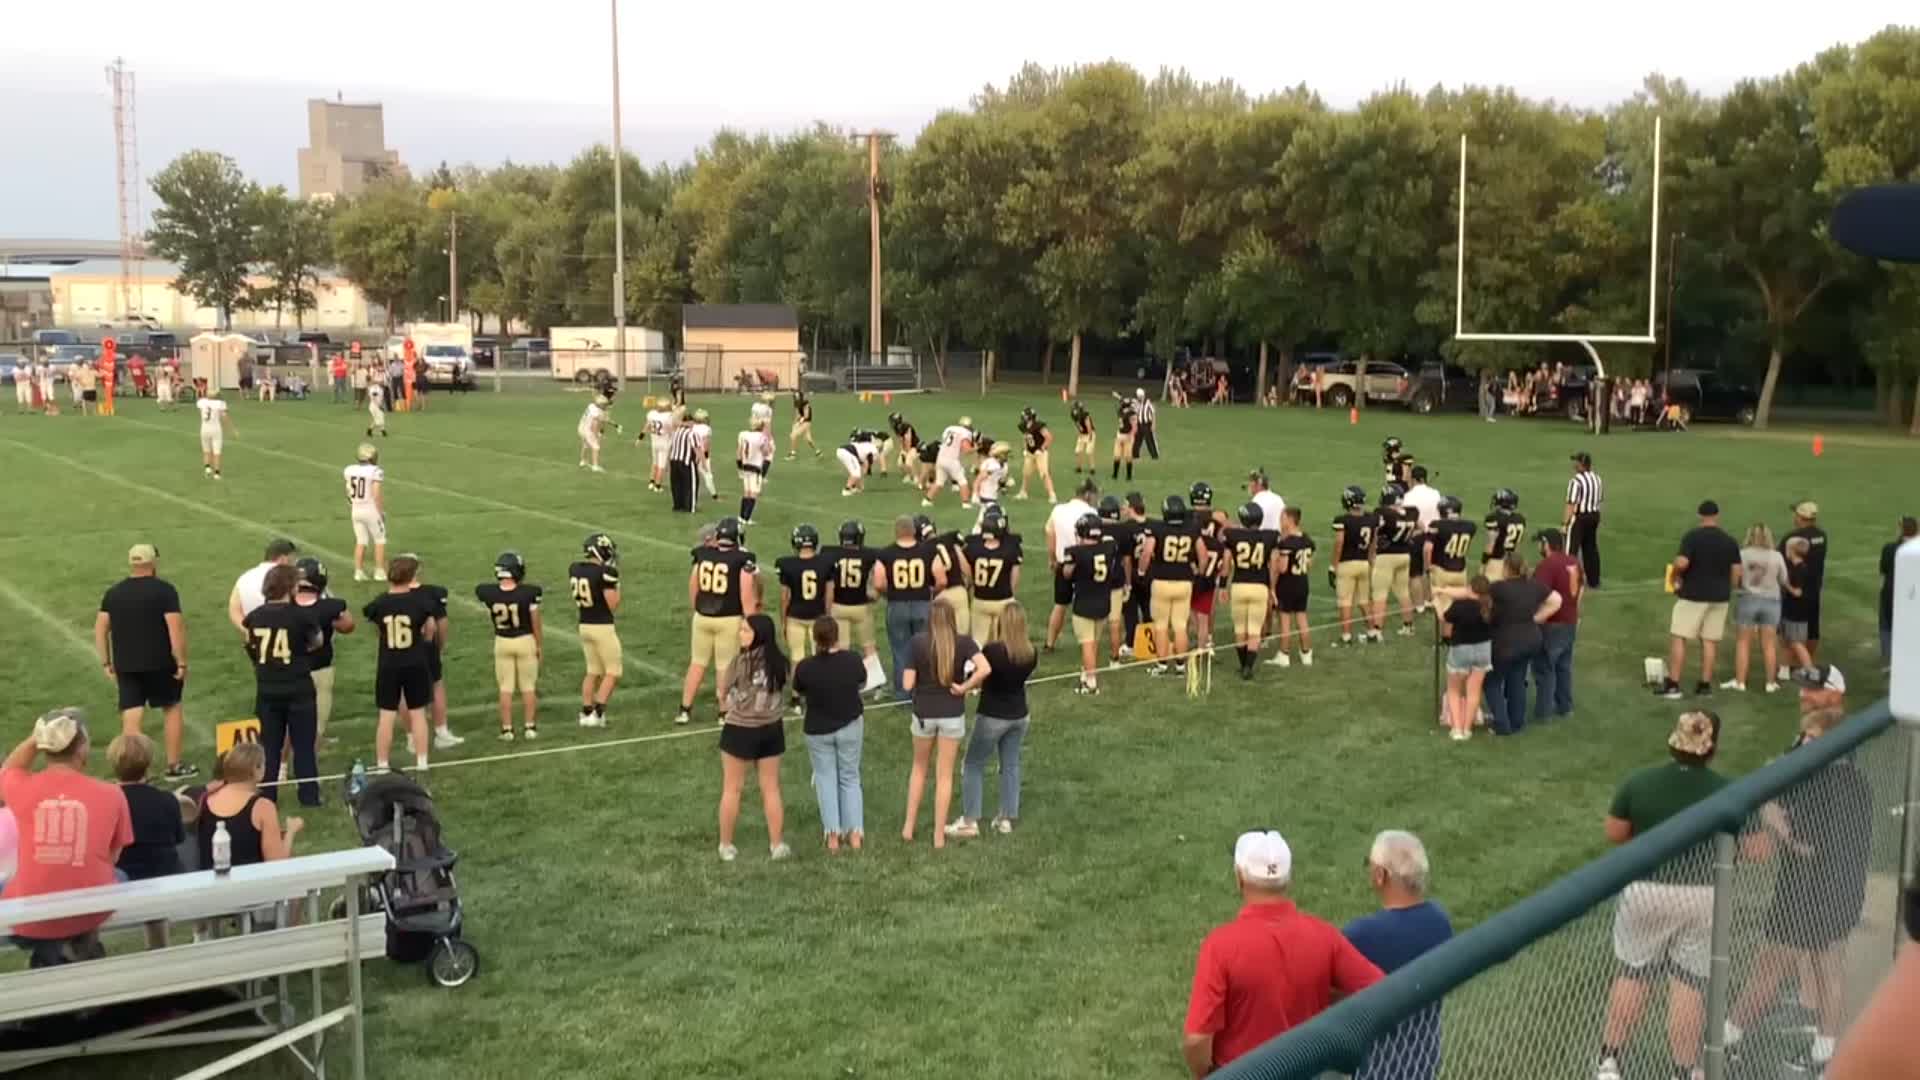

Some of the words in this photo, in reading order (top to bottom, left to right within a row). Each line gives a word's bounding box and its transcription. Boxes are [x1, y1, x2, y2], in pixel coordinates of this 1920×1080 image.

[350, 476, 365, 499] 50
[1163, 535, 1191, 562] 62
[1359, 527, 1371, 550] 3
[1444, 533, 1471, 558] 40
[1504, 523, 1524, 549] 27
[1093, 554, 1107, 582] 5
[1236, 542, 1264, 569] 24
[699, 560, 728, 594] 66
[801, 570, 817, 600] 6
[839, 558, 861, 588] 15
[893, 558, 925, 589] 60
[974, 558, 1004, 588] 67
[493, 603, 520, 629] 21
[253, 628, 292, 664] 74
[383, 615, 413, 649] 16
